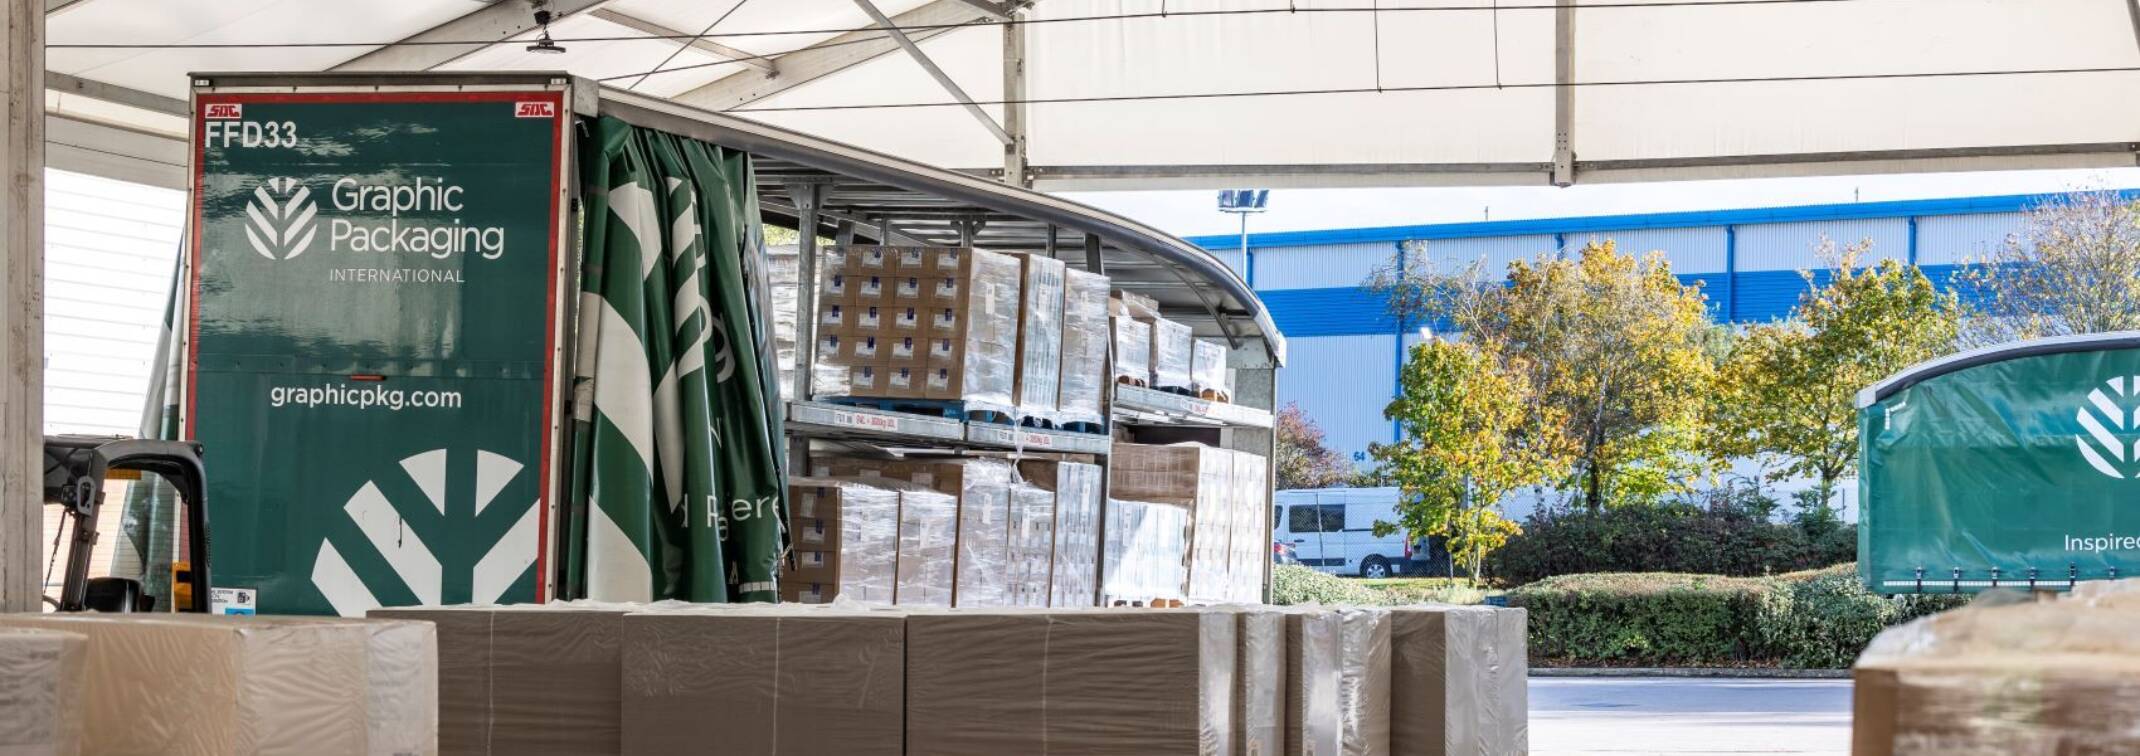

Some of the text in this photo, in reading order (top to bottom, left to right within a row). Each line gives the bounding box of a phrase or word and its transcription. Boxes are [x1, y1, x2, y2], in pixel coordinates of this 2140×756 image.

[205, 121, 297, 148] FFD33
[332, 177, 464, 216] Graphic
[331, 218, 504, 260] Packaging
[330, 268, 465, 283] INTERNATIONAL
[271, 383, 462, 411] graphicpkg.com
